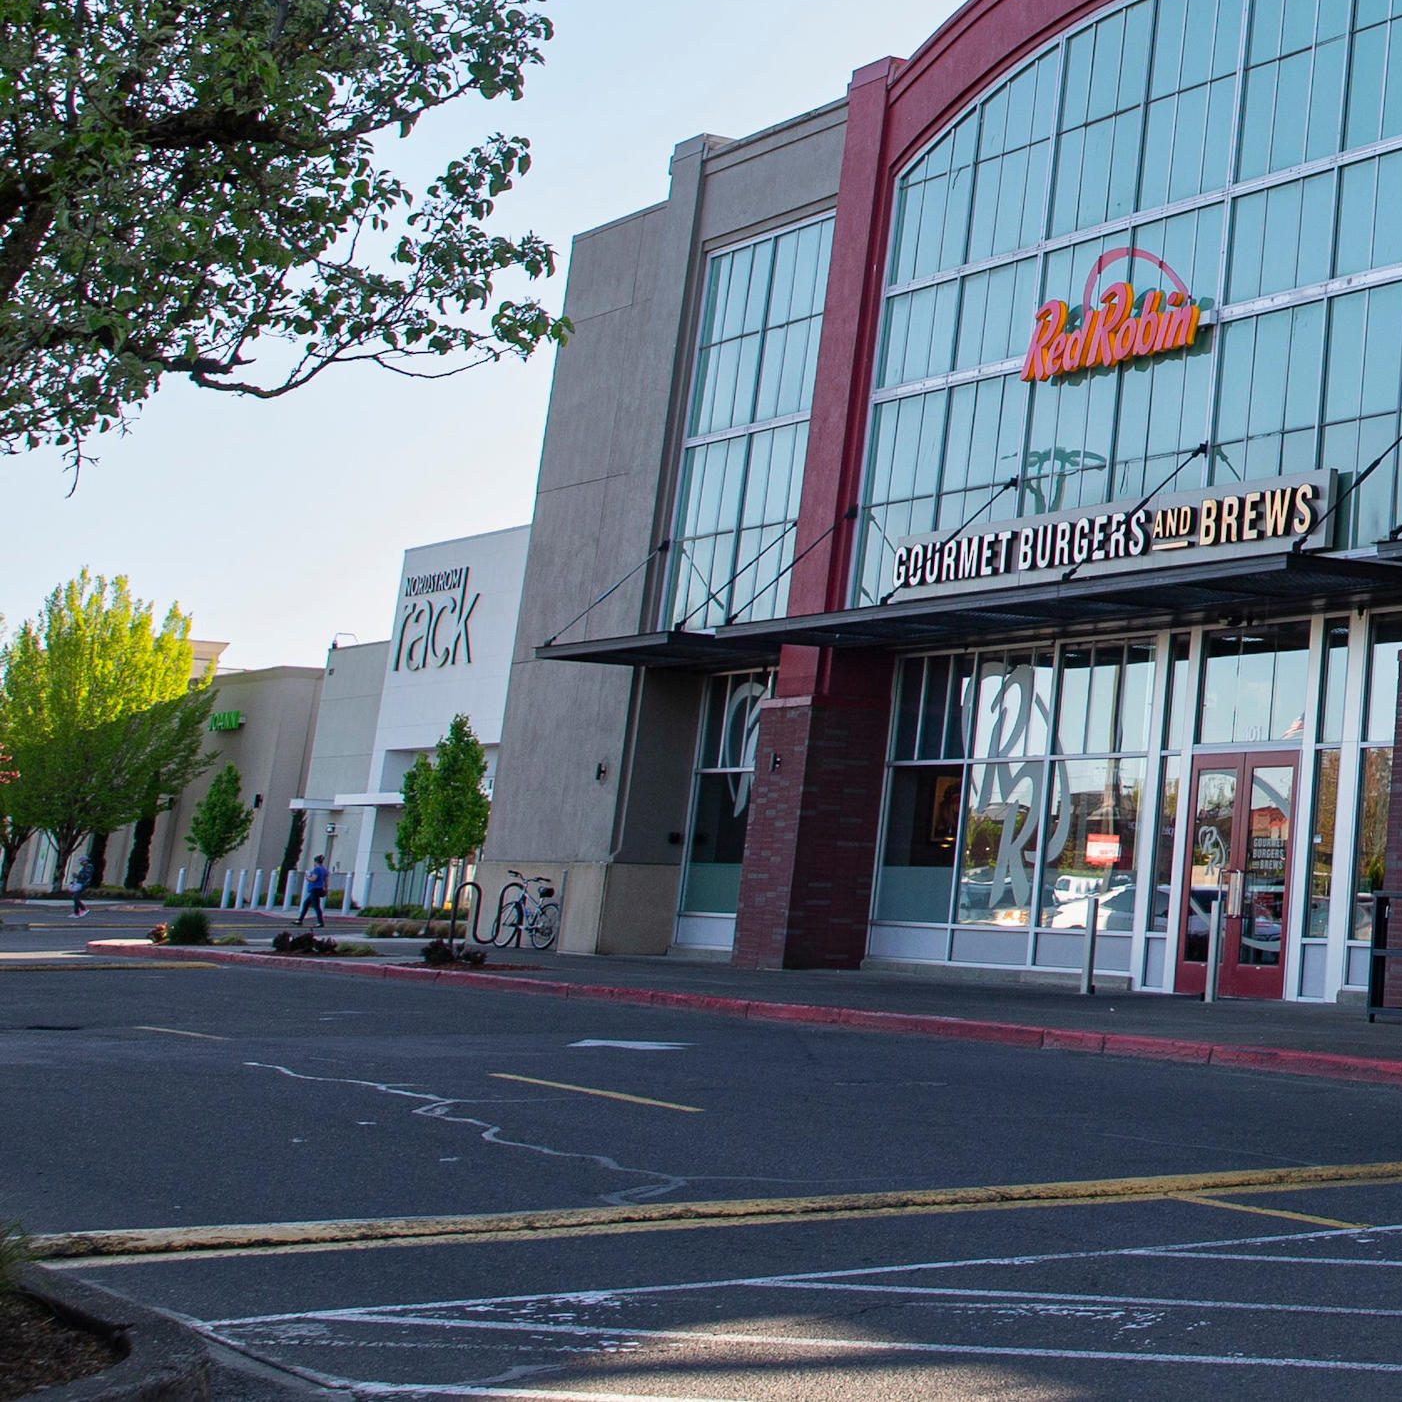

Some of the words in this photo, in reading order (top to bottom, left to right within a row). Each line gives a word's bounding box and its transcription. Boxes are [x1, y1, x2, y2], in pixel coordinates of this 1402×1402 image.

[1019, 299, 1096, 382] Red
[1086, 282, 1200, 367] Robin
[892, 530, 1015, 588] GOURMET
[1018, 509, 1149, 571] BURGERS
[1152, 506, 1192, 540] AND
[1199, 484, 1316, 546] BREWS
[404, 567, 463, 597] NORDSTROM
[392, 565, 481, 672] rack
[1252, 848, 1285, 859] BURGERS
[1253, 838, 1285, 848] GOURMET
